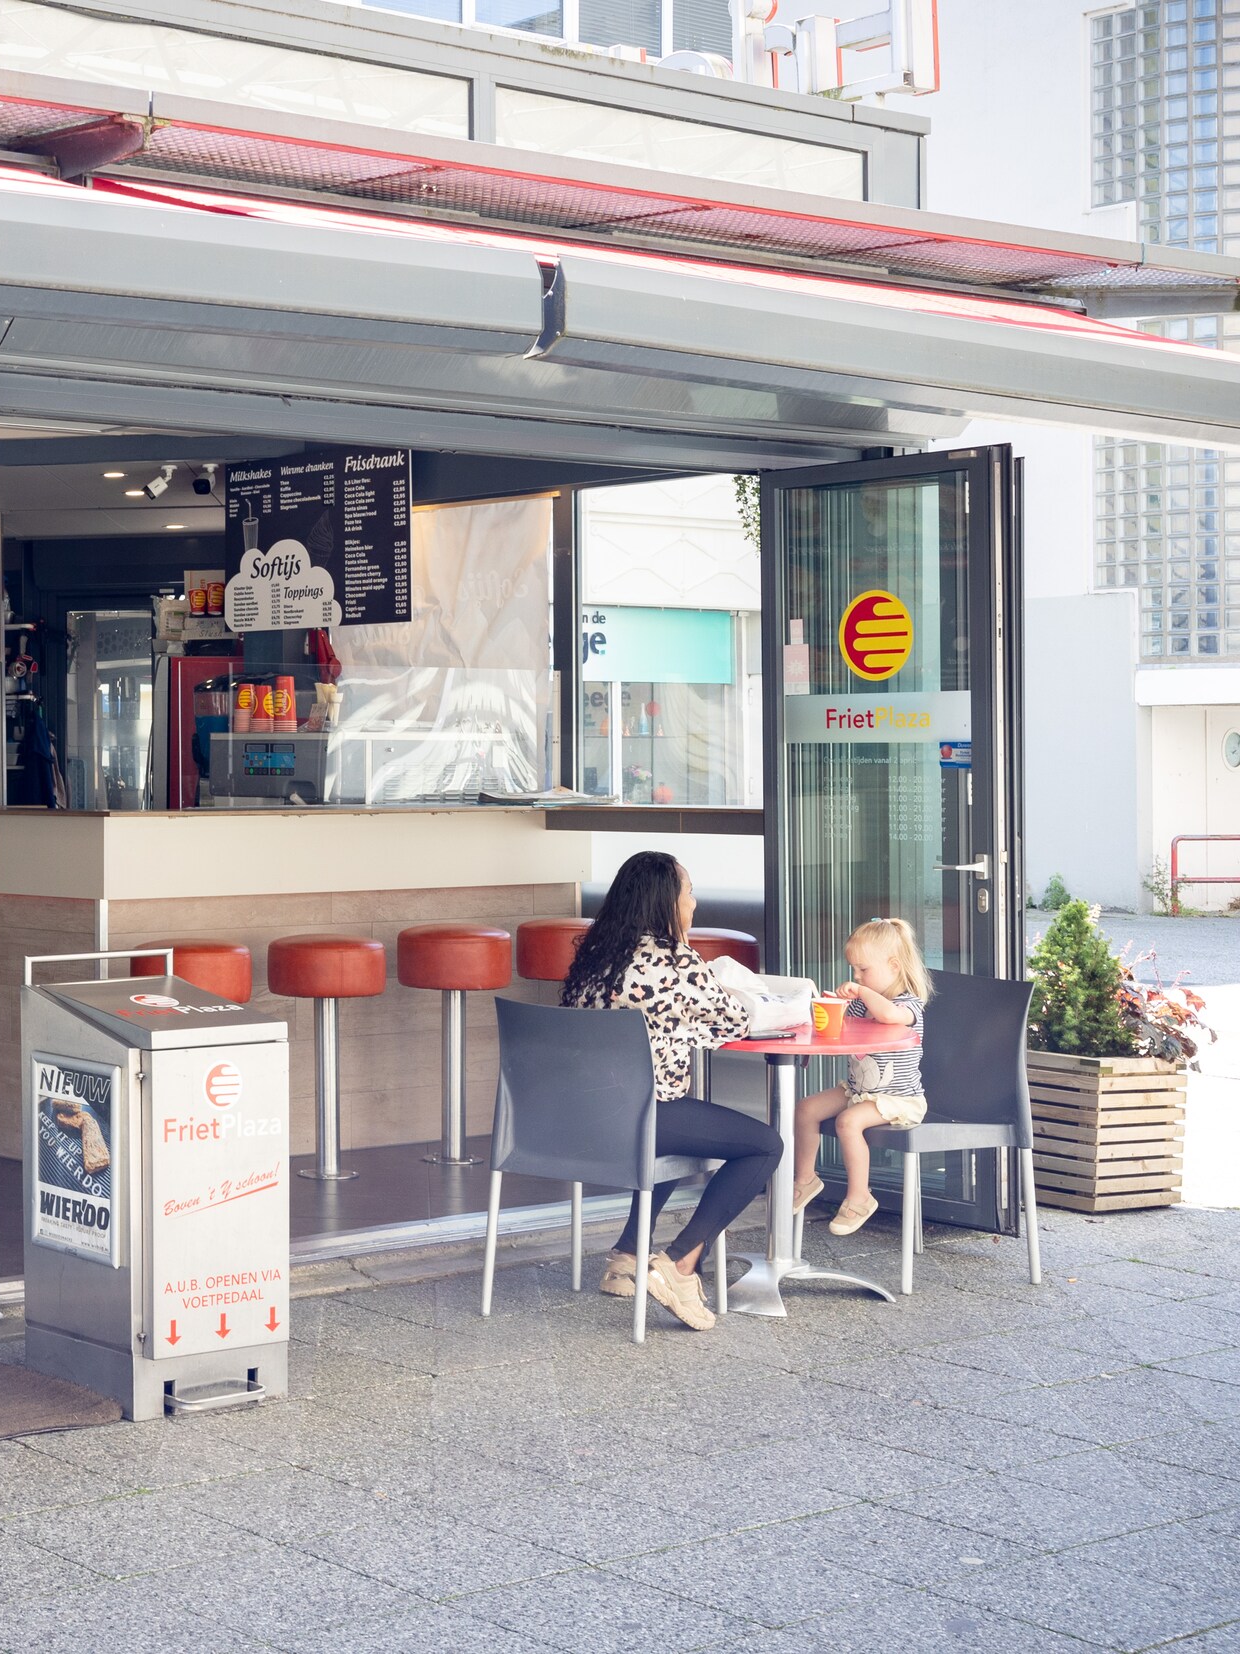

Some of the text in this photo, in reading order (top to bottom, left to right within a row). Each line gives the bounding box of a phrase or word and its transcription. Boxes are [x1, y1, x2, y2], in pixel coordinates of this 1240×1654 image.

[281, 462, 334, 476] Warme dranken
[345, 451, 404, 472] Frisdrank
[230, 469, 272, 482] Milkshakes
[251, 554, 301, 581] Softijs
[284, 585, 323, 600] Toppings
[592, 611, 606, 624] de
[826, 706, 931, 729] FrietPlaza
[114, 1003, 244, 1018] FrietPlaza
[40, 1068, 111, 1104] NIEUW
[39, 1112, 83, 1155] KEEP IT UP
[163, 1112, 283, 1143] FrietPlaza
[39, 1127, 56, 1147] YOU
[56, 1146, 102, 1196] WIERDO
[164, 1197, 201, 1216] Boven
[235, 1161, 281, 1191] schoon!
[164, 1269, 281, 1294] A.U.B. OPENEN VIA
[182, 1288, 264, 1309] VOETPEDAAL
